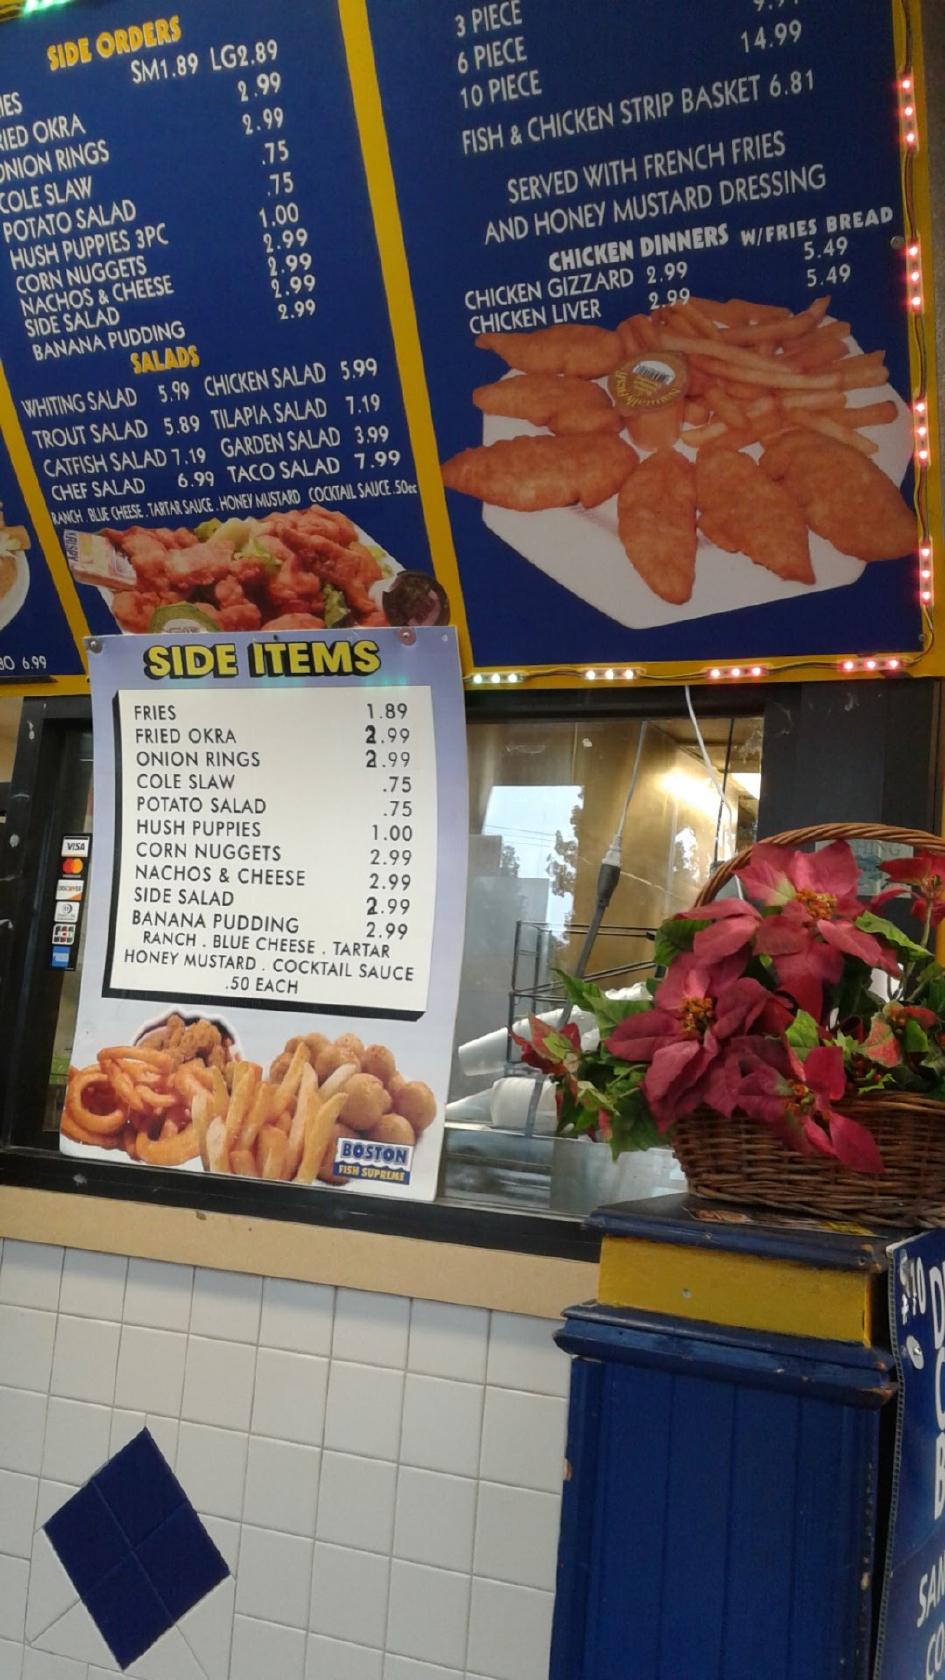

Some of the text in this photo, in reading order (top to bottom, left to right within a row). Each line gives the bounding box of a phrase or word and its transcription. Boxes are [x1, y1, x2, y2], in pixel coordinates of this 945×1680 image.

[455, 0, 522, 37] 3 PIECE
[47, 15, 182, 71] SIDE ORDERS
[457, 36, 527, 74] 6 PIECE
[0, 39, 278, 118] IES SM1.89 LG2.89
[460, 19, 802, 108] 10 PIECE 14.99
[32, 113, 86, 143] OKRA
[237, 72, 281, 102] 2.99
[462, 69, 813, 154] FISH & CHICKEN STRIP BASKET 6.81
[55, 139, 109, 171] RINGS
[242, 107, 283, 135] 2.99
[0, 140, 289, 214] COLE SLAW .75
[507, 130, 786, 204] SERVED WITH FRENCH FRIES
[3, 171, 294, 243] POTATO SALAD .75
[485, 164, 826, 245] AND HONEY MUSTARD DRESSING
[10, 202, 299, 270] HUSH PUPPIES 3PC 1.00
[549, 207, 893, 273] CHICKEN DINNERS W/FRIES BREAD
[16, 228, 308, 294] CORN NUGGETS 2.99
[465, 236, 848, 310] CHICKEN GIZZARD 2.99 5.49
[20, 253, 312, 317] NACHOS & CHEESE 2.99
[469, 264, 851, 335] CHICKEN LIVER 2.99 5.49
[25, 274, 315, 337] SIDE SALAD 2.99
[32, 299, 316, 361] BANANA PUDDING 2.99
[130, 345, 200, 374] SALADS
[204, 358, 377, 396] CHICKEN SALAD 5.99
[21, 381, 190, 418] WHITING SALAD 5.99
[210, 393, 380, 430] TILAPIA SALAD 7.19
[32, 415, 200, 449] TROUT SALAD 5.89
[220, 425, 389, 458] GARDEN SALAD 3.99
[43, 447, 206, 477] CATFISH SALAD 7.19
[227, 450, 400, 483] TACO SALAD 7.99
[50, 509, 84, 525] RANCH
[87, 507, 110, 522] BLUE
[110, 504, 144, 520] CHEESE
[147, 500, 183, 517] TARTAR
[182, 497, 214, 515] SAUCE
[219, 493, 253, 511] HONEY
[255, 489, 301, 508] MUSTARD
[308, 484, 357, 503] COCKTAIL
[357, 479, 392, 498] SAUCE
[51, 471, 214, 501] CHEF SALAD 6.99
[22, 655, 47, 670] 6.99
[146, 640, 382, 680] SIDE ITEMS
[134, 703, 407, 721] FRIES 1.89
[136, 725, 410, 744] FRIED OKRA 2.99
[136, 749, 410, 768] ONION RINGS 2.99
[137, 773, 411, 793] COLE SLAW .75
[137, 796, 412, 817] POTATO SALAD .75
[67, 842, 85, 851] VISA
[137, 819, 413, 842] HUSH PUPPIES 1.00
[136, 842, 412, 866] CORN NUGGETS 2.99
[135, 864, 411, 891] NACHOS & CHEESE 2.99
[134, 886, 410, 916] SIDE SALAD 2.99
[132, 909, 408, 940] BANANA PUDDING 2.99
[143, 930, 390, 958] RANCH BLUE CHEESE TARTAR
[124, 949, 414, 981] HONEY MUSTARD COCKTAIL SAUCE
[225, 976, 298, 994] .50 EACH
[342, 1141, 408, 1163] BOSTON
[338, 1165, 405, 1181] FISH SUPREME
